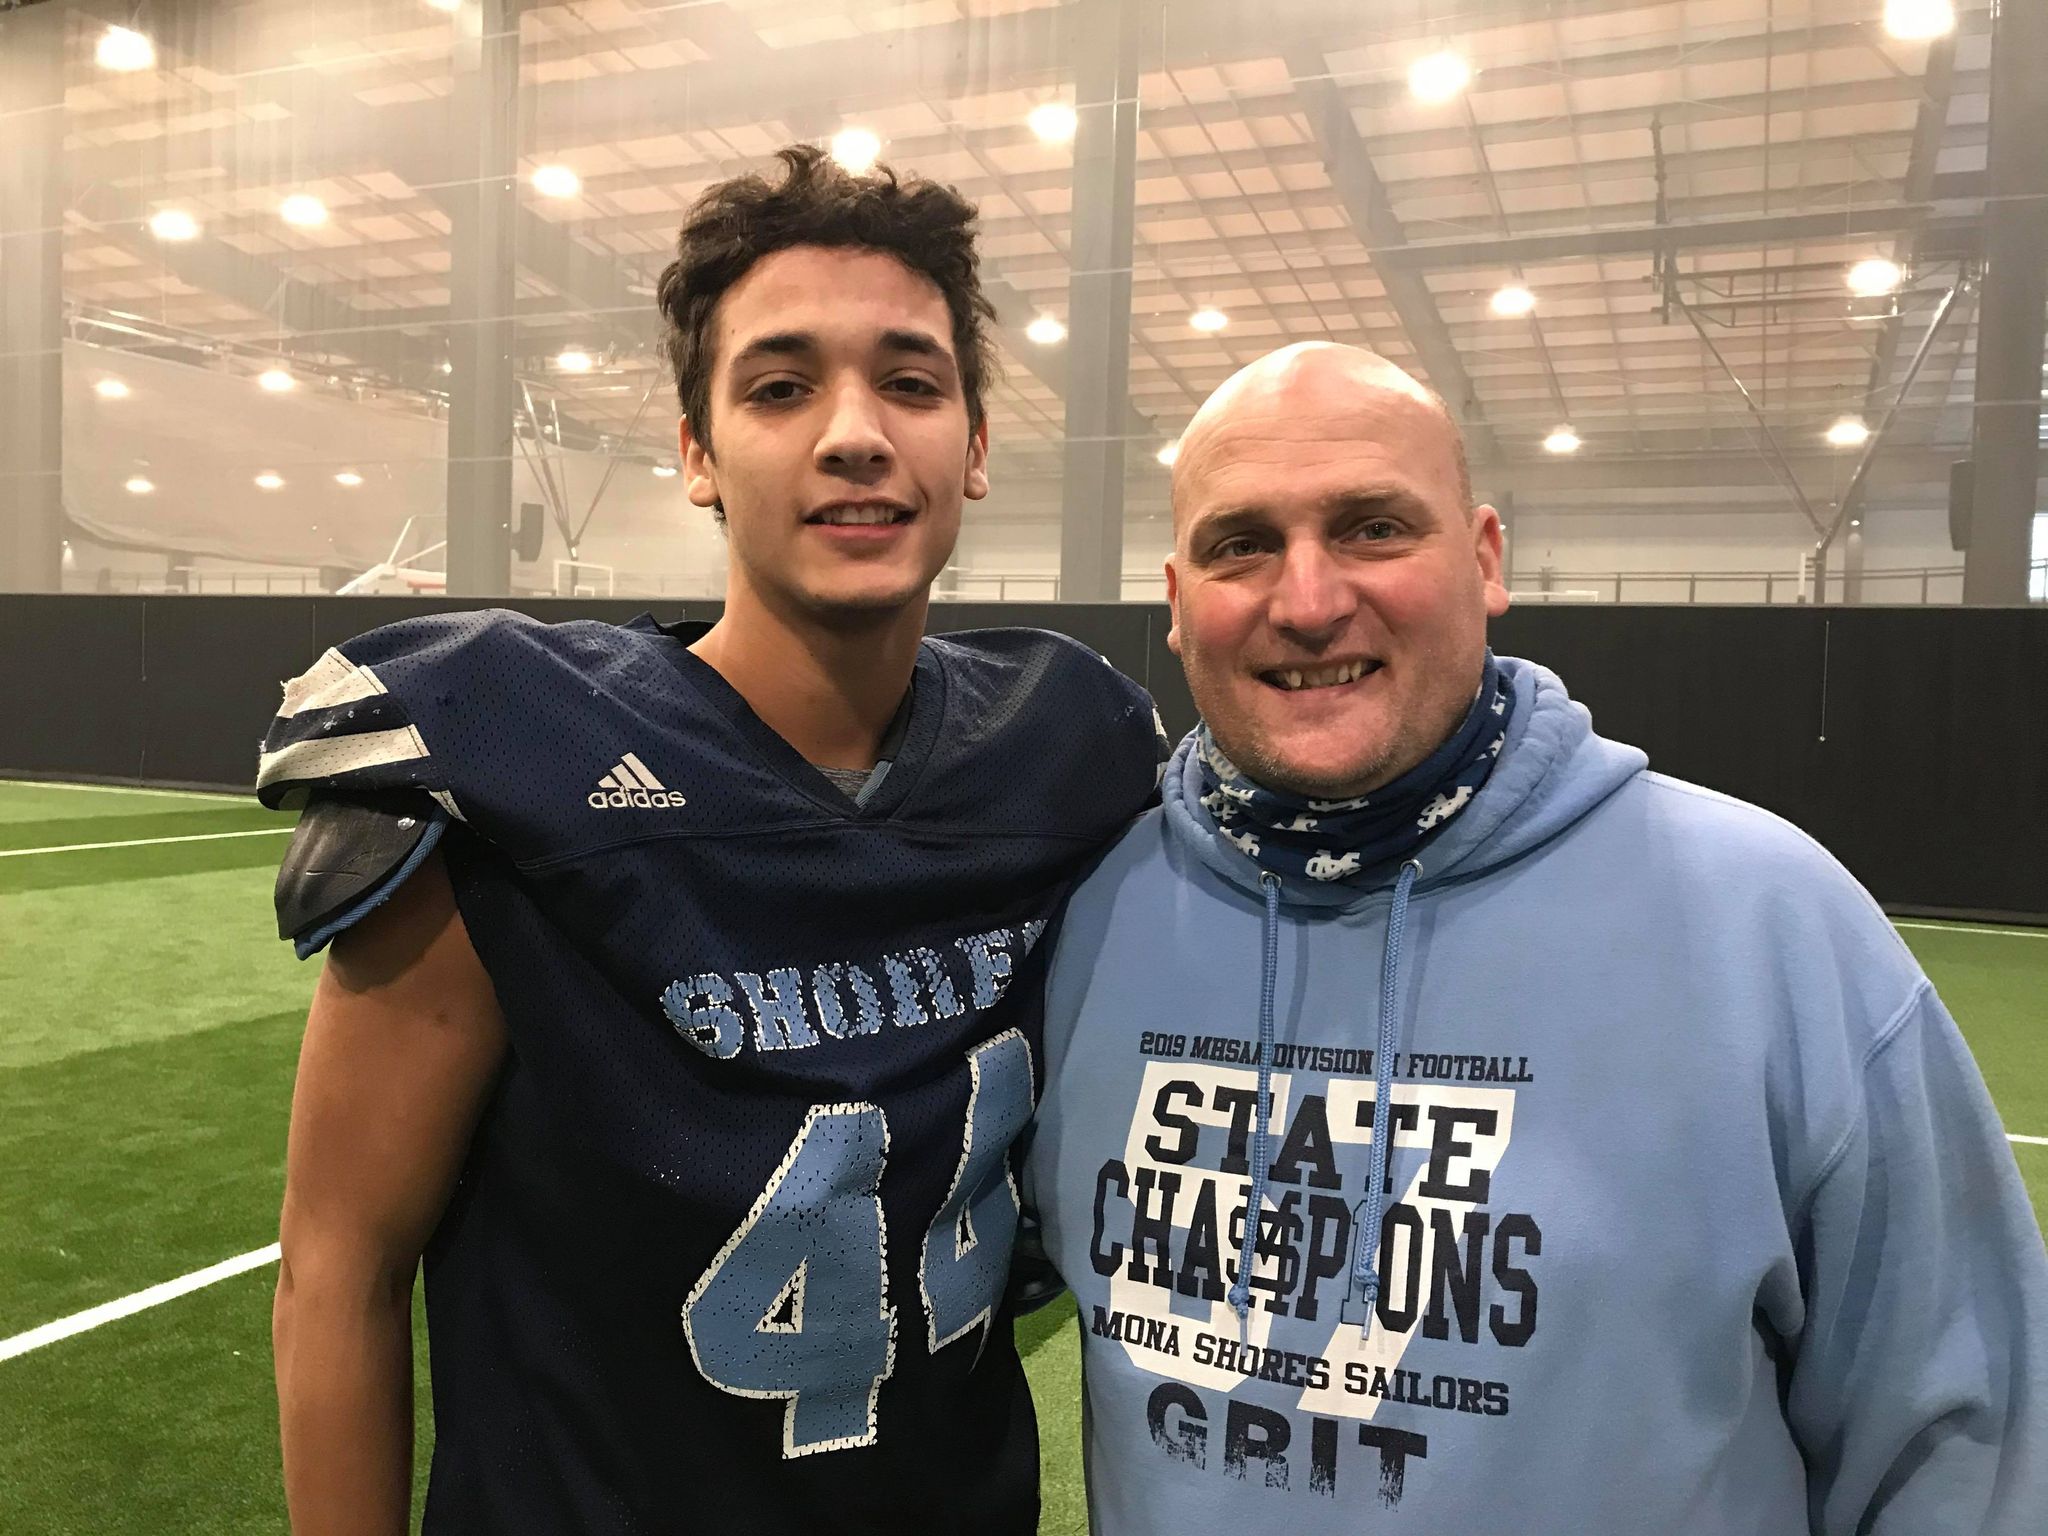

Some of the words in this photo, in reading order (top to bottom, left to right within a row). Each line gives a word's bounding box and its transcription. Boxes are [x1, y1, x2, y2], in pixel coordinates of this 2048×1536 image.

[588, 785, 686, 808] adidas
[1139, 1031, 1186, 1057] 2019
[1189, 1036, 1264, 1065] MHSAA
[1271, 1043, 1374, 1075] DIVISION
[1407, 1053, 1533, 1082] FOOTBALL
[1144, 1080, 1498, 1204] STATE
[681, 1027, 1035, 1459] 44
[1091, 1305, 1179, 1356] MONA
[1193, 1333, 1329, 1390] SHORES
[1344, 1362, 1509, 1416] SAILORS
[1147, 1382, 1428, 1512] GRIT
